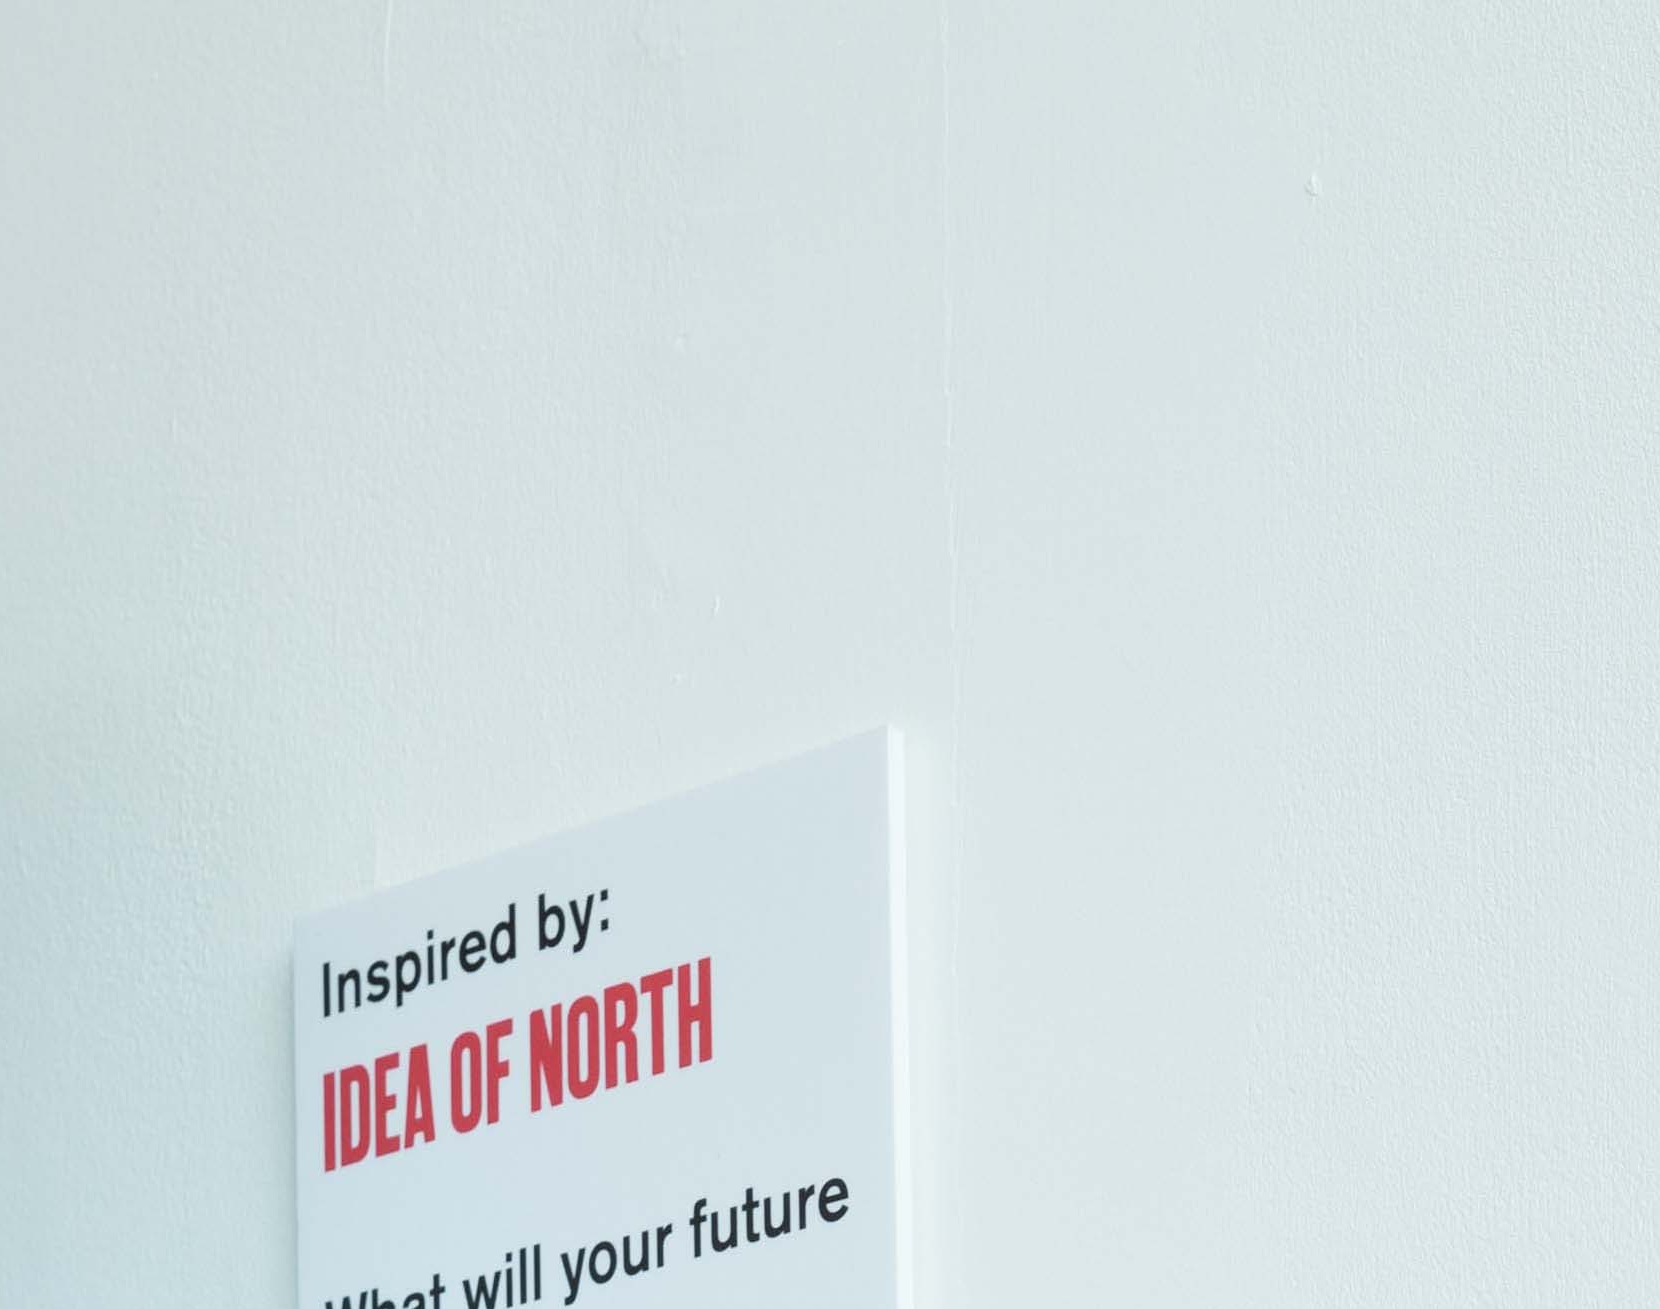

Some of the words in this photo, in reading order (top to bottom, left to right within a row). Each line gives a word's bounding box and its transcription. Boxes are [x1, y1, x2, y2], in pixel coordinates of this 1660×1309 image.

[322, 902, 518, 1018] Inspired
[537, 888, 611, 956] by:
[323, 1043, 435, 1173] IDEA
[449, 1017, 514, 1134] OF
[528, 956, 714, 1114] NORTH
[560, 1222, 674, 1306] your
[688, 1176, 850, 1260] future
